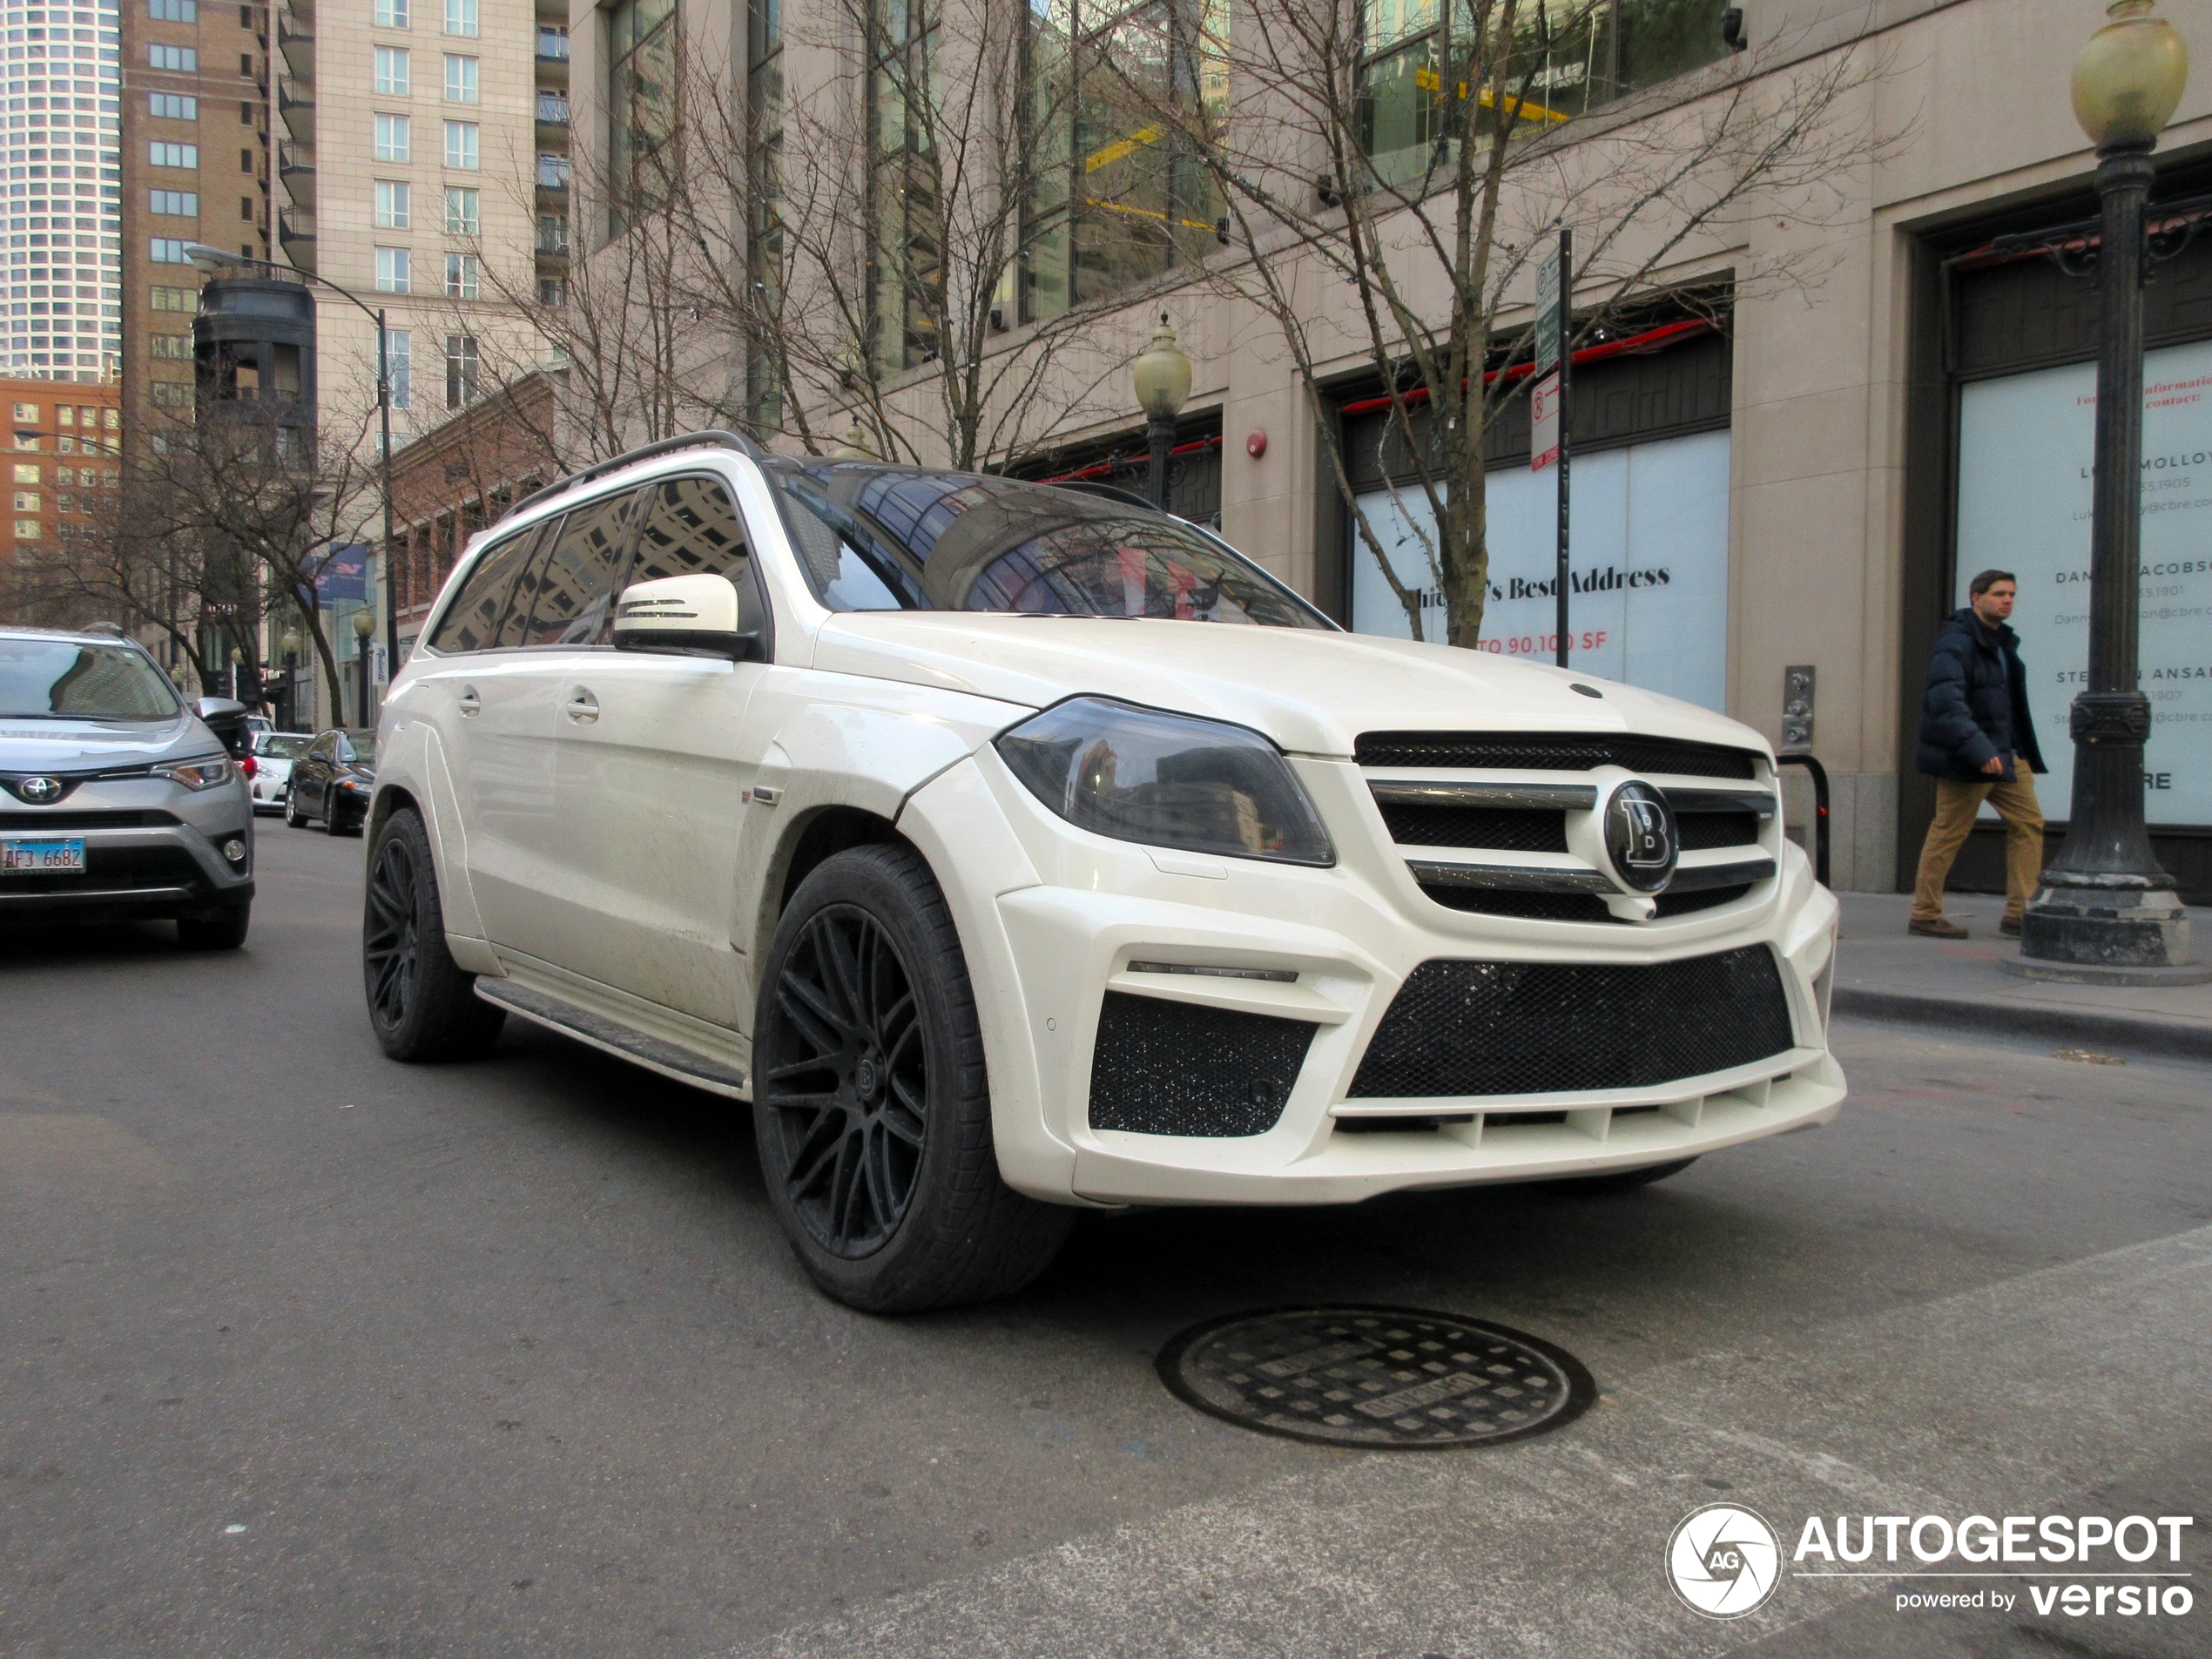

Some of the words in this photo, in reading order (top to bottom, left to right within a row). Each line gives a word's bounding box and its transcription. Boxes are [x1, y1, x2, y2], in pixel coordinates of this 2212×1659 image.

[2144, 375, 2212, 395] nformatio
[2146, 393, 2202, 409] contact:
[2141, 451, 2212, 469] MOLLO
[2055, 570, 2092, 584] DAN
[2140, 560, 2212, 577] ACOBS
[1509, 577, 1558, 601] Best
[1568, 567, 1670, 594] Address
[1478, 638, 1502, 654] TO
[1581, 631, 1608, 651] SF
[2151, 666, 2212, 680] ANSA
[2143, 772, 2172, 790] RE
[1620, 799, 1670, 868] B
[6, 849, 34, 868] AF3
[44, 848, 81, 867] 6682
